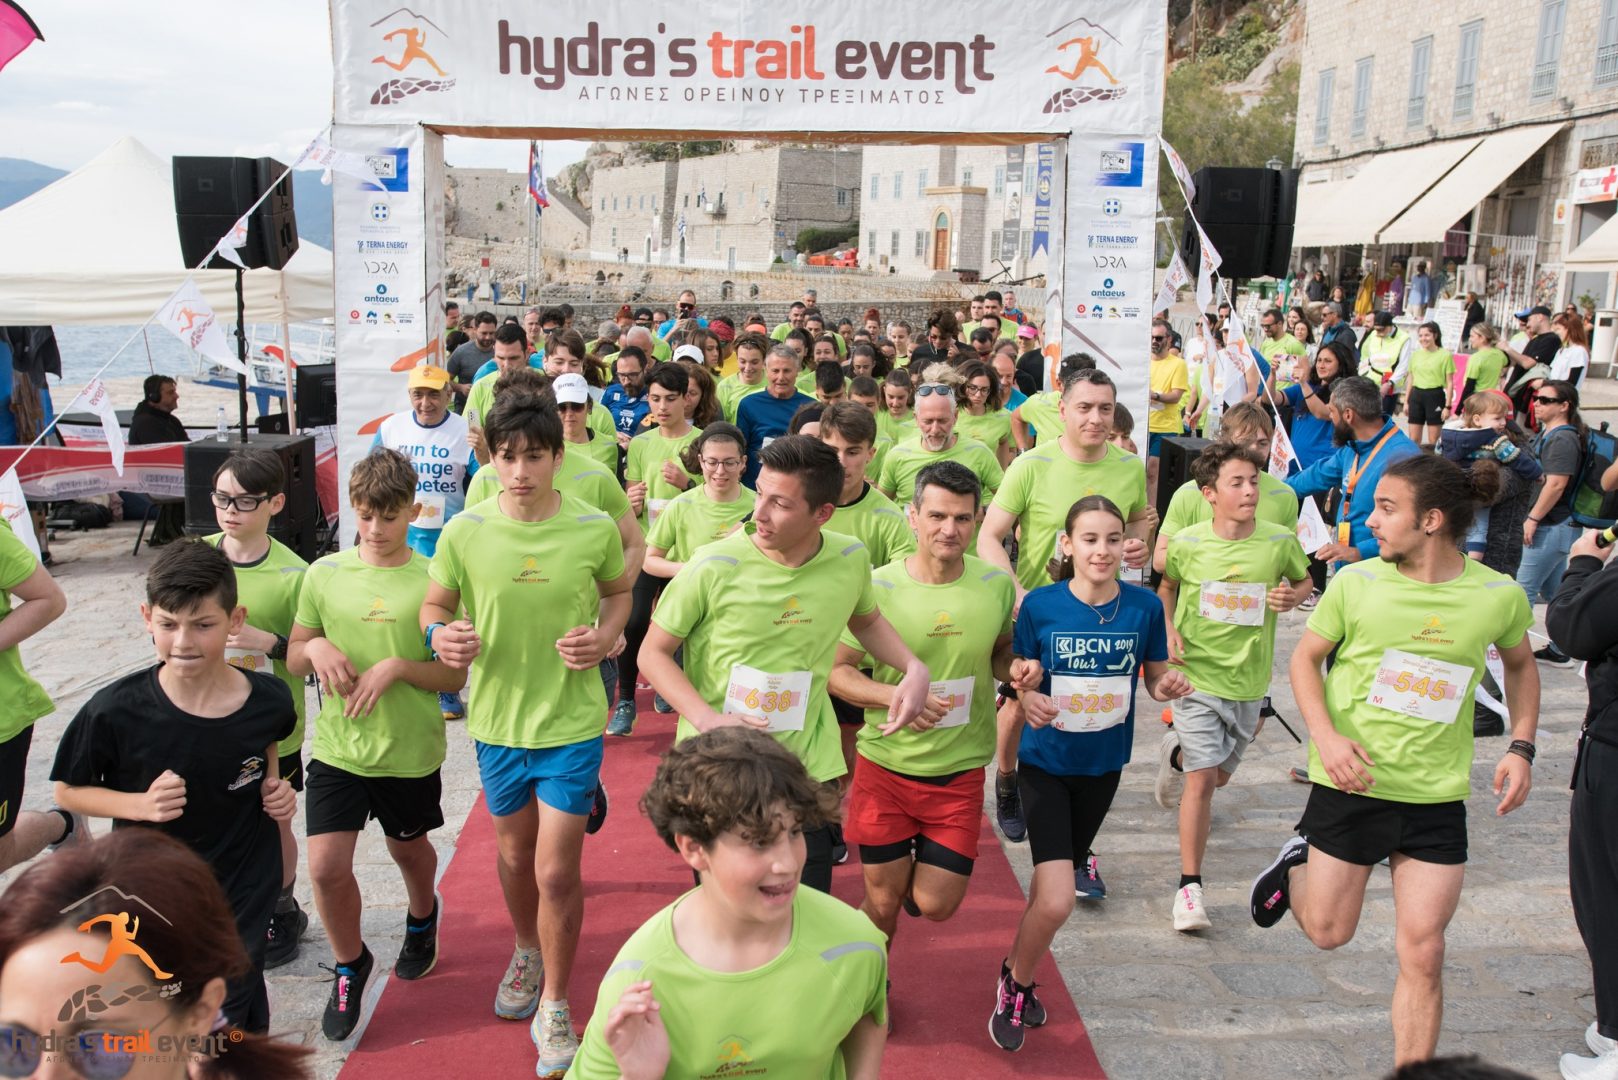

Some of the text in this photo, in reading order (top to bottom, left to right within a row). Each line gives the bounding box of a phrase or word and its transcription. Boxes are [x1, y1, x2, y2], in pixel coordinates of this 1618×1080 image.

[498, 19, 996, 95] hydra's trail event
[579, 86, 945, 105] ΑΓΩΝΕΣ ΟΡΕΙΝΟΥ ΤΡΕΞΙΜΑΤΟΣ
[366, 240, 408, 249] TERNA ENERGY
[1096, 235, 1114, 243] TERNA
[364, 295, 400, 303] antaeus
[1091, 289, 1126, 297] antaeus
[431, 445, 450, 458] to
[412, 462, 453, 479] ange
[1215, 593, 1252, 612] 559
[1075, 638, 1134, 653] BCN 2019
[1393, 671, 1449, 702] 545
[745, 688, 792, 712] 638
[1069, 693, 1115, 714] 523
[1373, 695, 1384, 705] M
[1055, 721, 1065, 729] M
